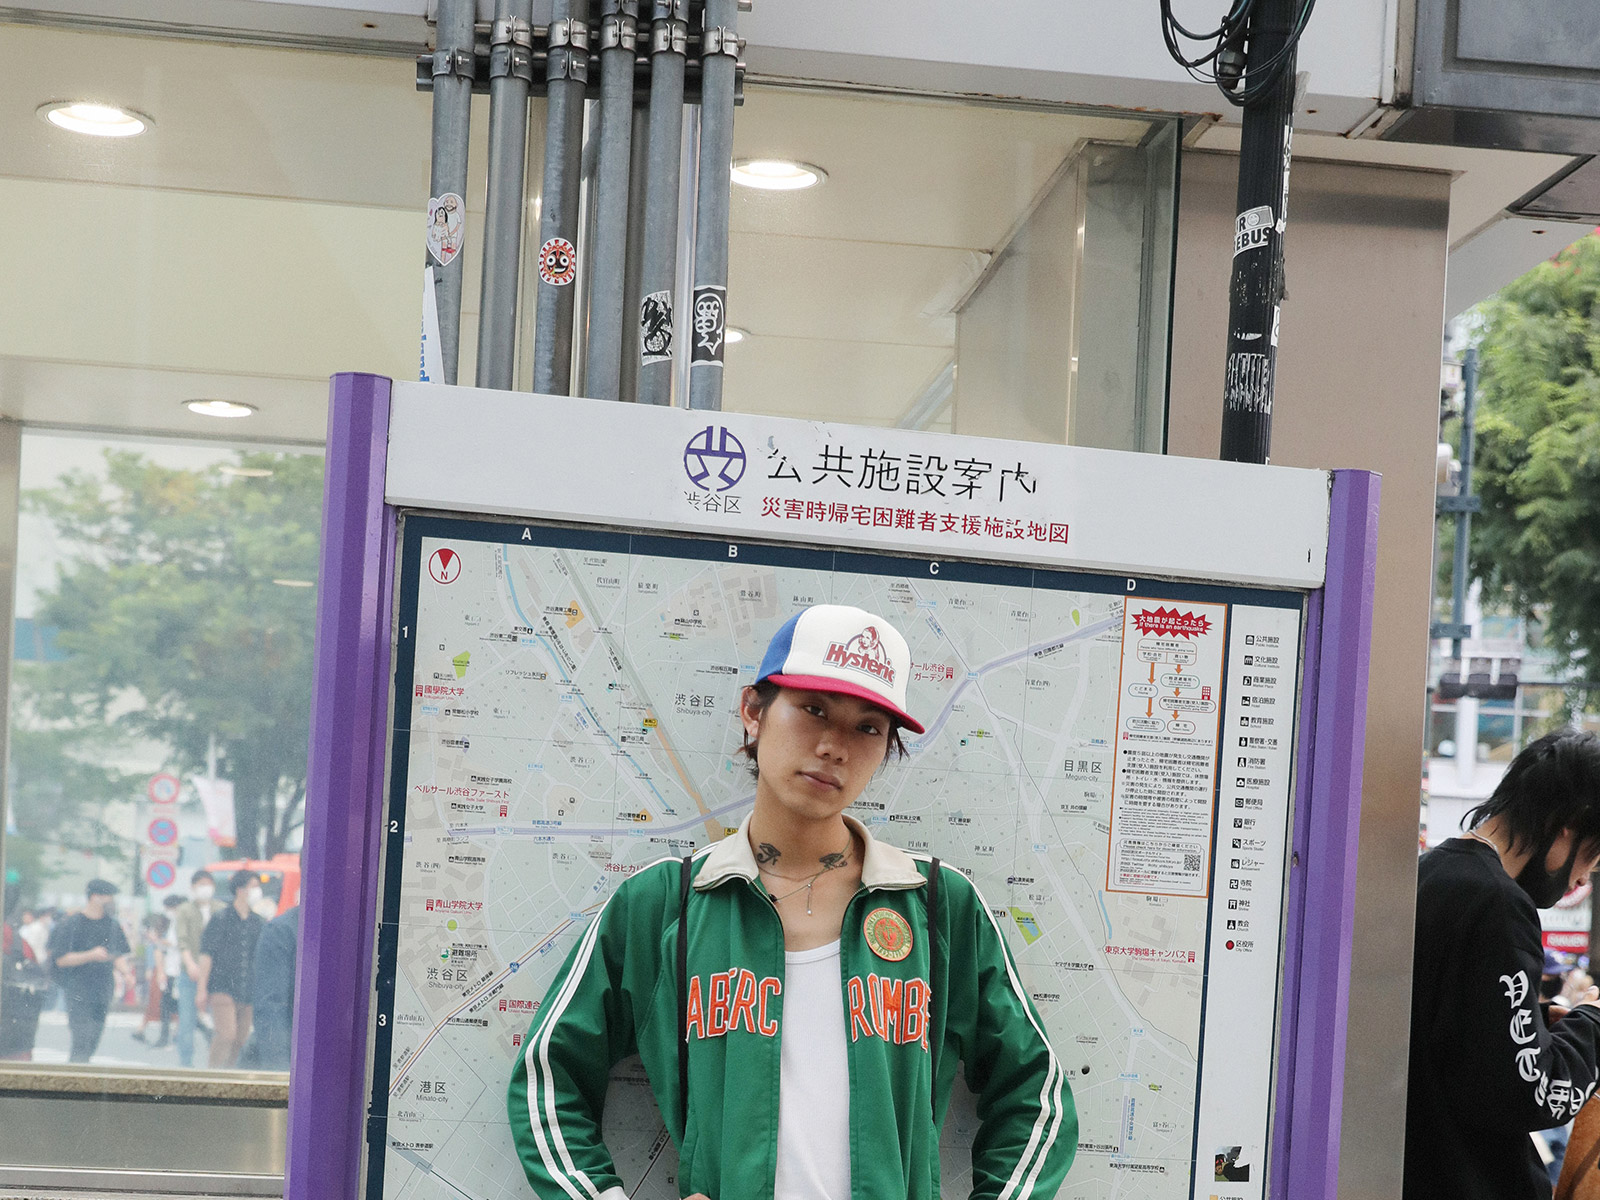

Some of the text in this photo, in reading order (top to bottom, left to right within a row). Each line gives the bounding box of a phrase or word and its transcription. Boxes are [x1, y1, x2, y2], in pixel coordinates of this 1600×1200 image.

[684, 490, 742, 515] 渋谷区
[761, 496, 1069, 544] 災害時帰宅困難者支援施設地図
[522, 528, 531, 540] A
[728, 545, 737, 557] B
[930, 562, 939, 574] C
[441, 571, 448, 580] N
[1127, 579, 1136, 591] D
[1139, 615, 1204, 626] 大地震が起こったら
[402, 626, 408, 638] 1
[826, 643, 895, 683] Hysteric
[913, 673, 944, 683] ガーデン
[675, 693, 715, 707] 渋谷区
[676, 706, 713, 717] Shibuya-city
[1064, 760, 1102, 773] 目黒区
[1065, 773, 1099, 782] Meguro-city
[414, 785, 510, 798] ベルサール渋谷ファースト
[390, 821, 398, 832] 2
[1243, 839, 1266, 847] スポーツ
[1241, 859, 1264, 867] レジャー
[435, 900, 483, 910] 青山学院大学
[1105, 946, 1186, 959] 東京大学駒場キャンパス
[427, 968, 468, 981] 渋谷区
[428, 981, 465, 991] Shibuya-city
[379, 1014, 386, 1026] 3
[420, 1081, 446, 1094] 港区
